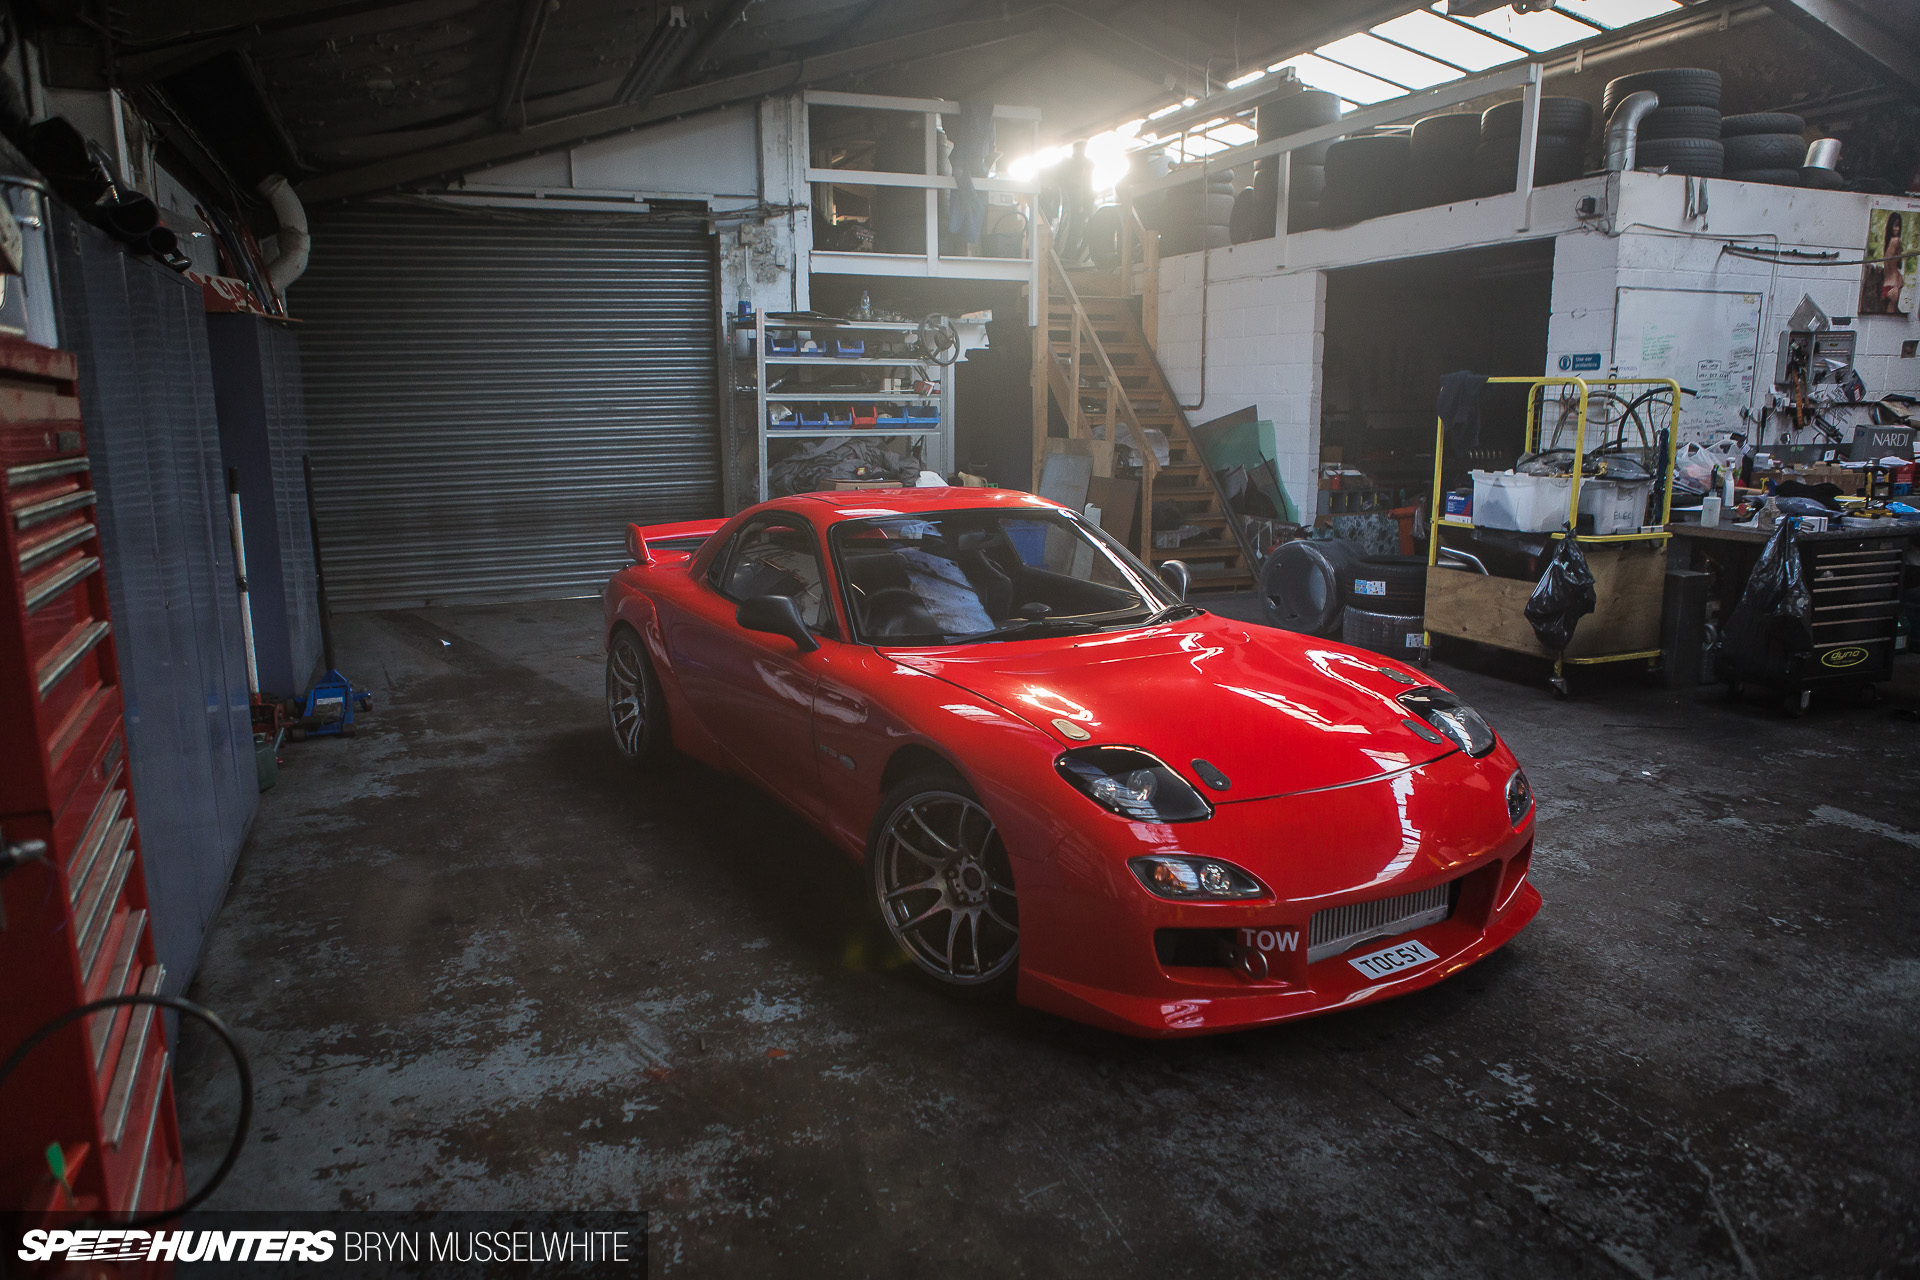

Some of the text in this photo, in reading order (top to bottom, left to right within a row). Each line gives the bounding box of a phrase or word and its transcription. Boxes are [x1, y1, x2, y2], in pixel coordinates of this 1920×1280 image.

[1872, 432, 1909, 447] NARDI
[1831, 650, 1860, 660] dyno
[1241, 928, 1300, 952] TOW
